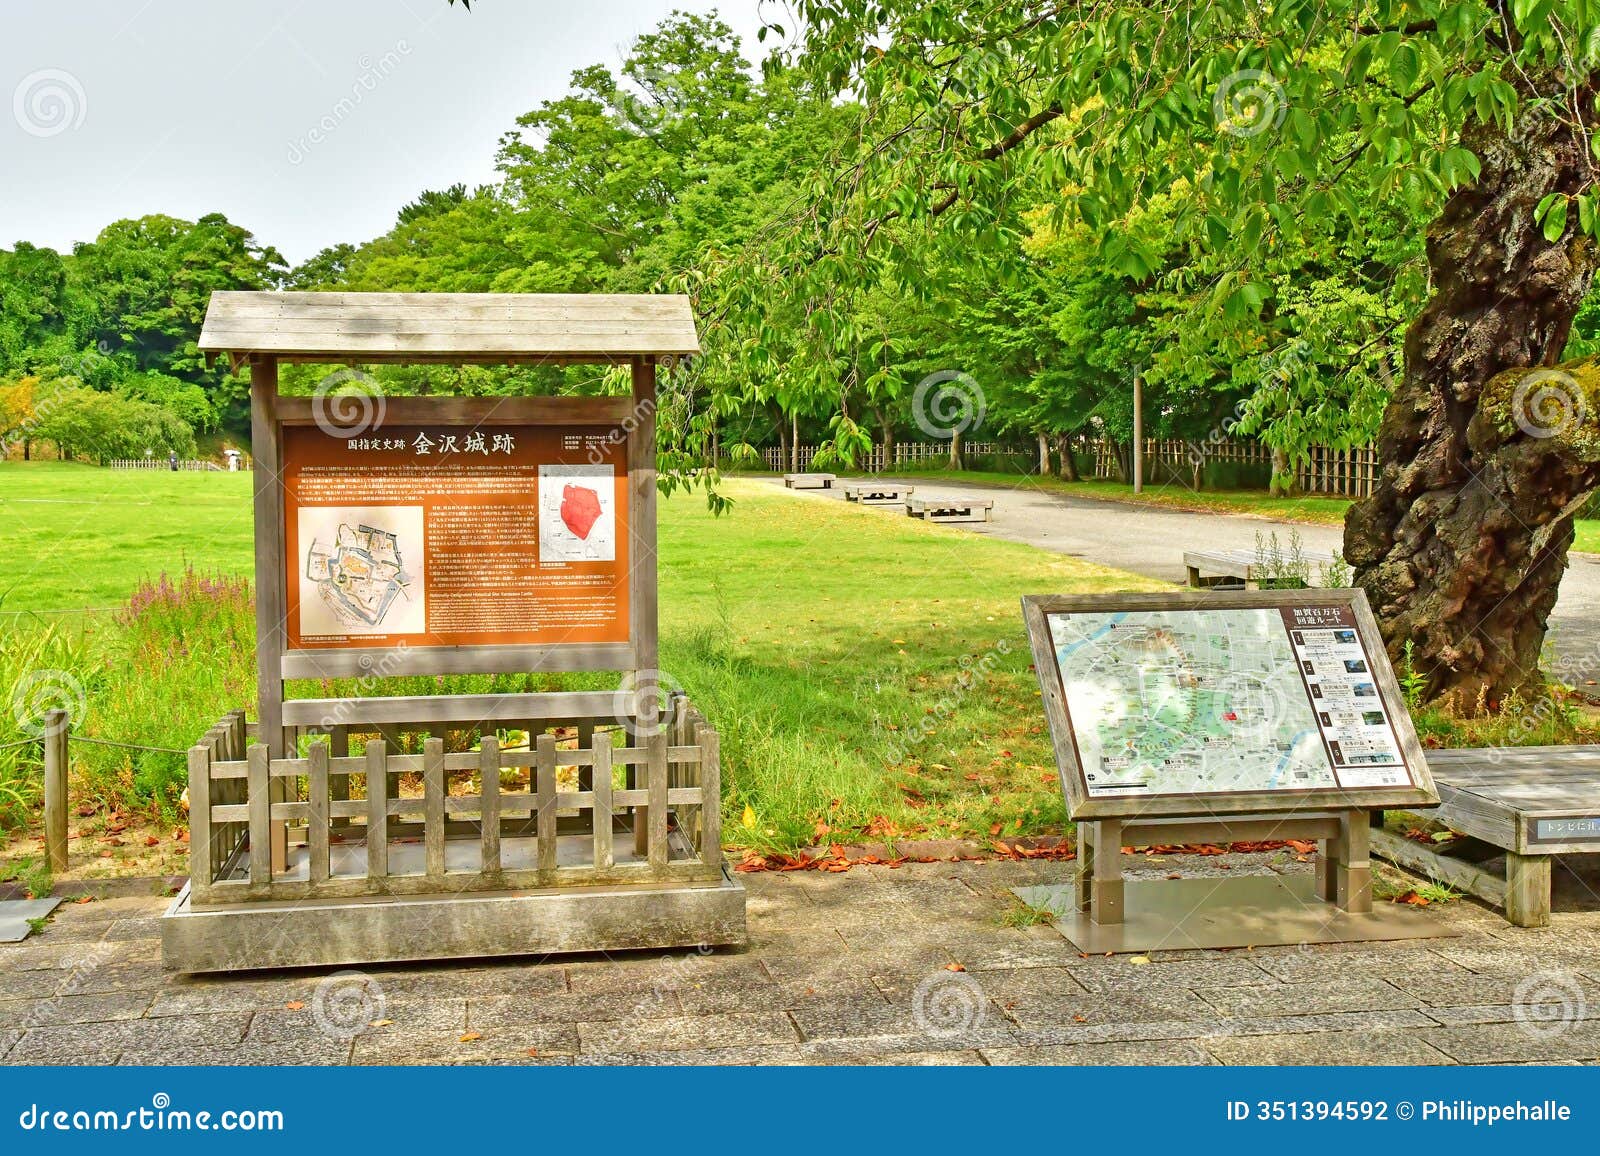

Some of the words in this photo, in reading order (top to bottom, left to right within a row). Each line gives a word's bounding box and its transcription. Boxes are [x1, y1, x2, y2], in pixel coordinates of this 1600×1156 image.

[346, 436, 407, 451] 国指定史跡
[410, 430, 516, 457] 金沢城跡
[1296, 616, 1342, 625] 回遊ルート
